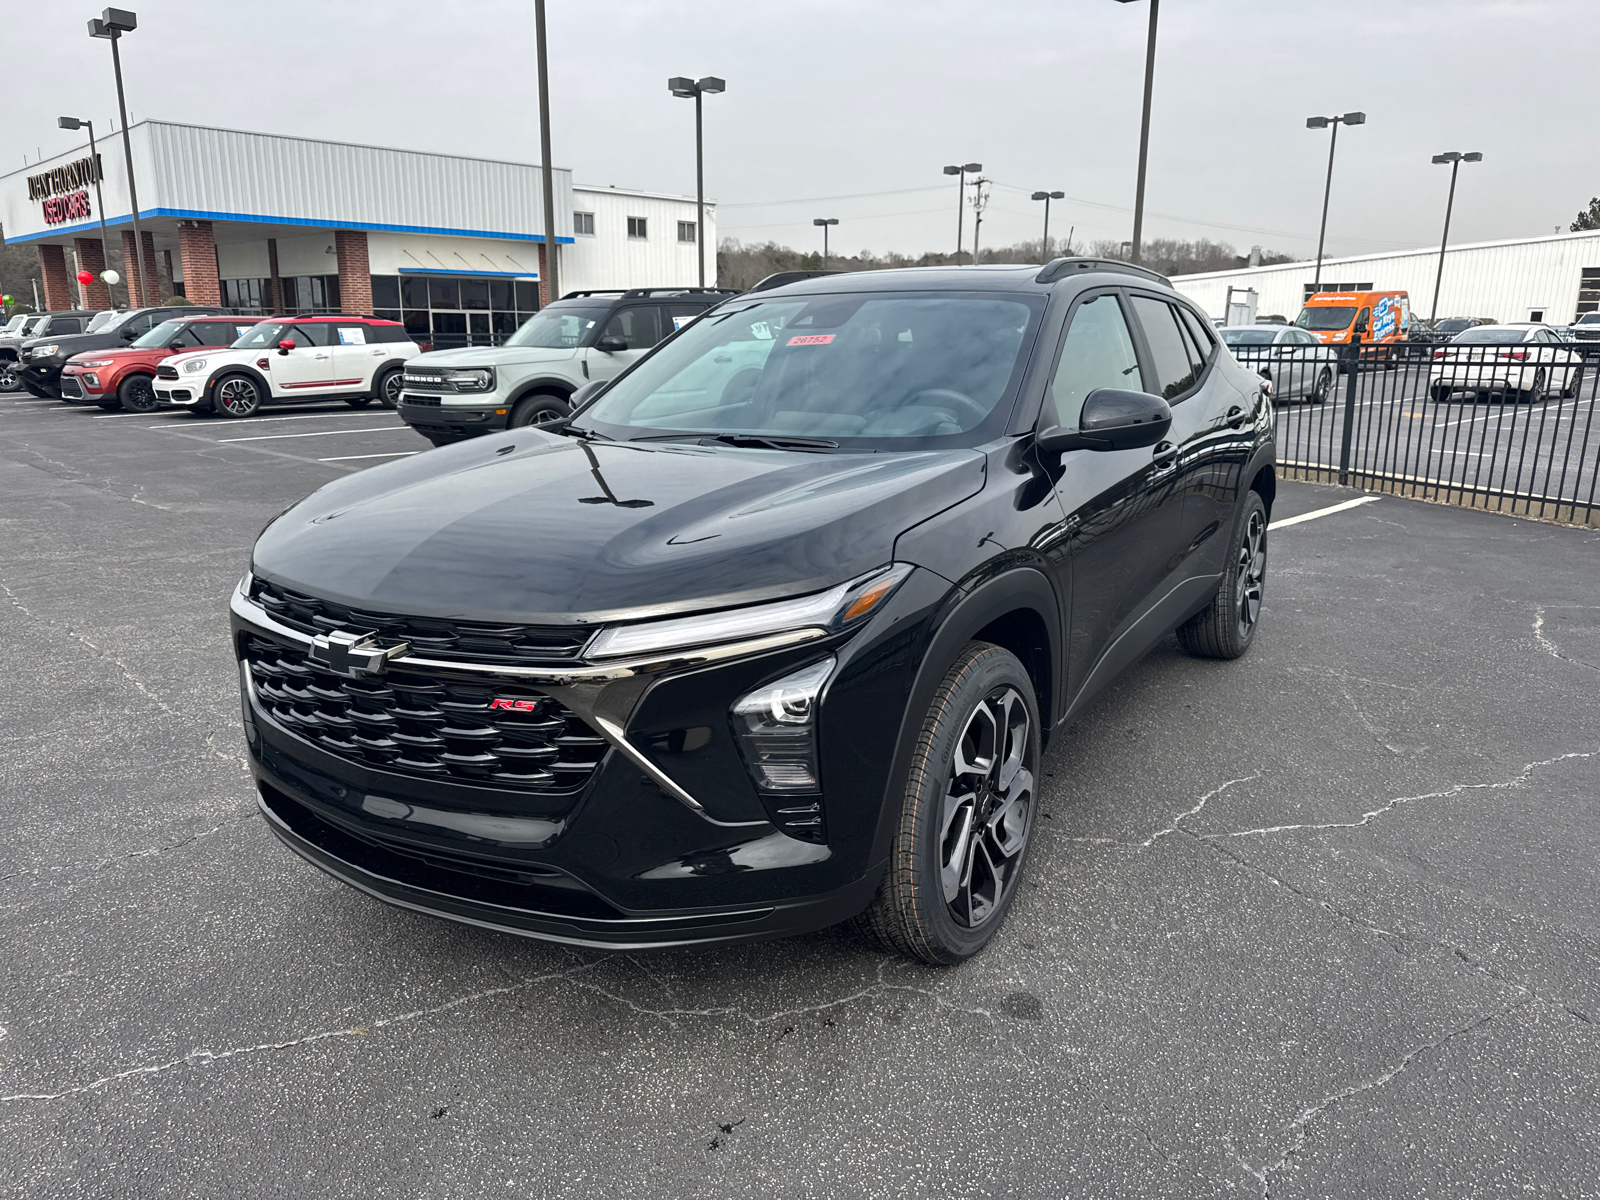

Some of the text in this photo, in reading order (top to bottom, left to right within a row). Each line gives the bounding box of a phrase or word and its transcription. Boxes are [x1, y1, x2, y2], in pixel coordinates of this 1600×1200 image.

[42, 190, 89, 224] USED CARS
[793, 336, 827, 344] 26752
[491, 699, 537, 712] RS
